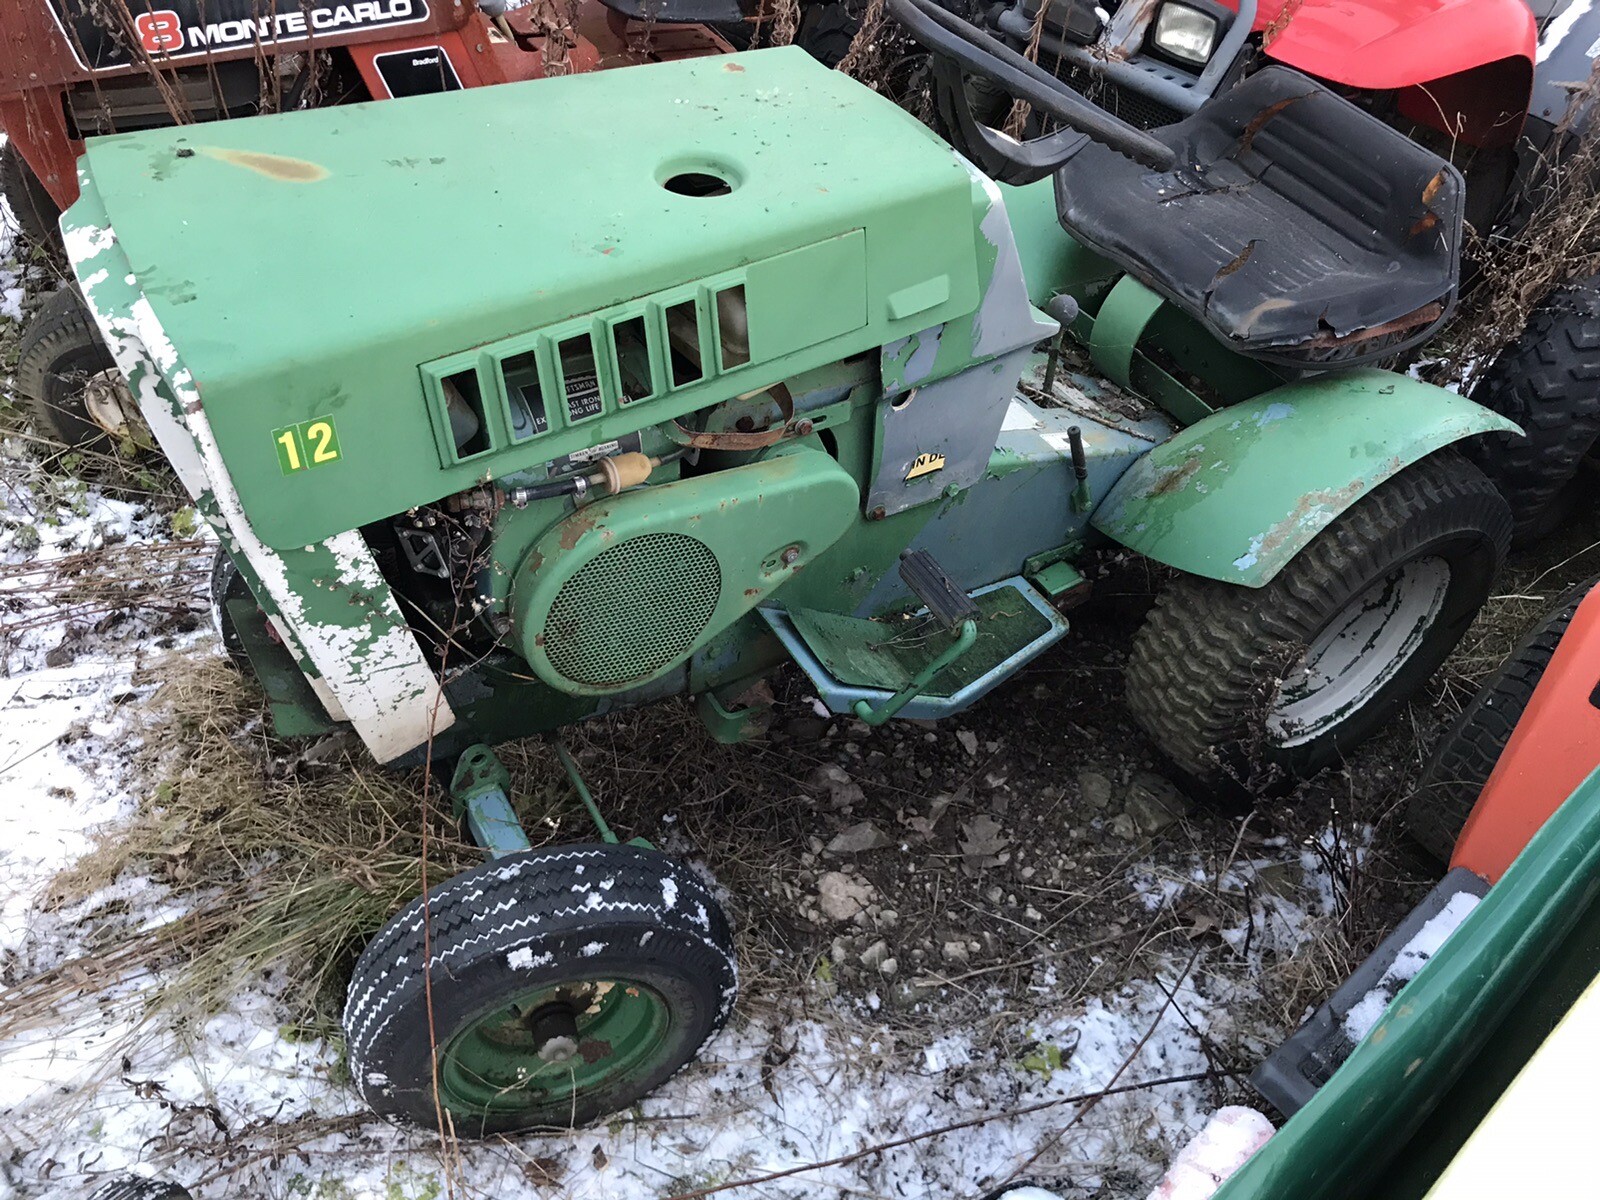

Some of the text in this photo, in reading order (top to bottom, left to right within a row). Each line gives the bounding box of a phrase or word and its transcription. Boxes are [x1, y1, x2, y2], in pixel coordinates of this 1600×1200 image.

[187, 12, 307, 48] MONTE
[311, 0, 412, 30] CARLO
[581, 396, 600, 405] IRON
[585, 403, 599, 412] LIFE
[278, 422, 337, 469] 12
